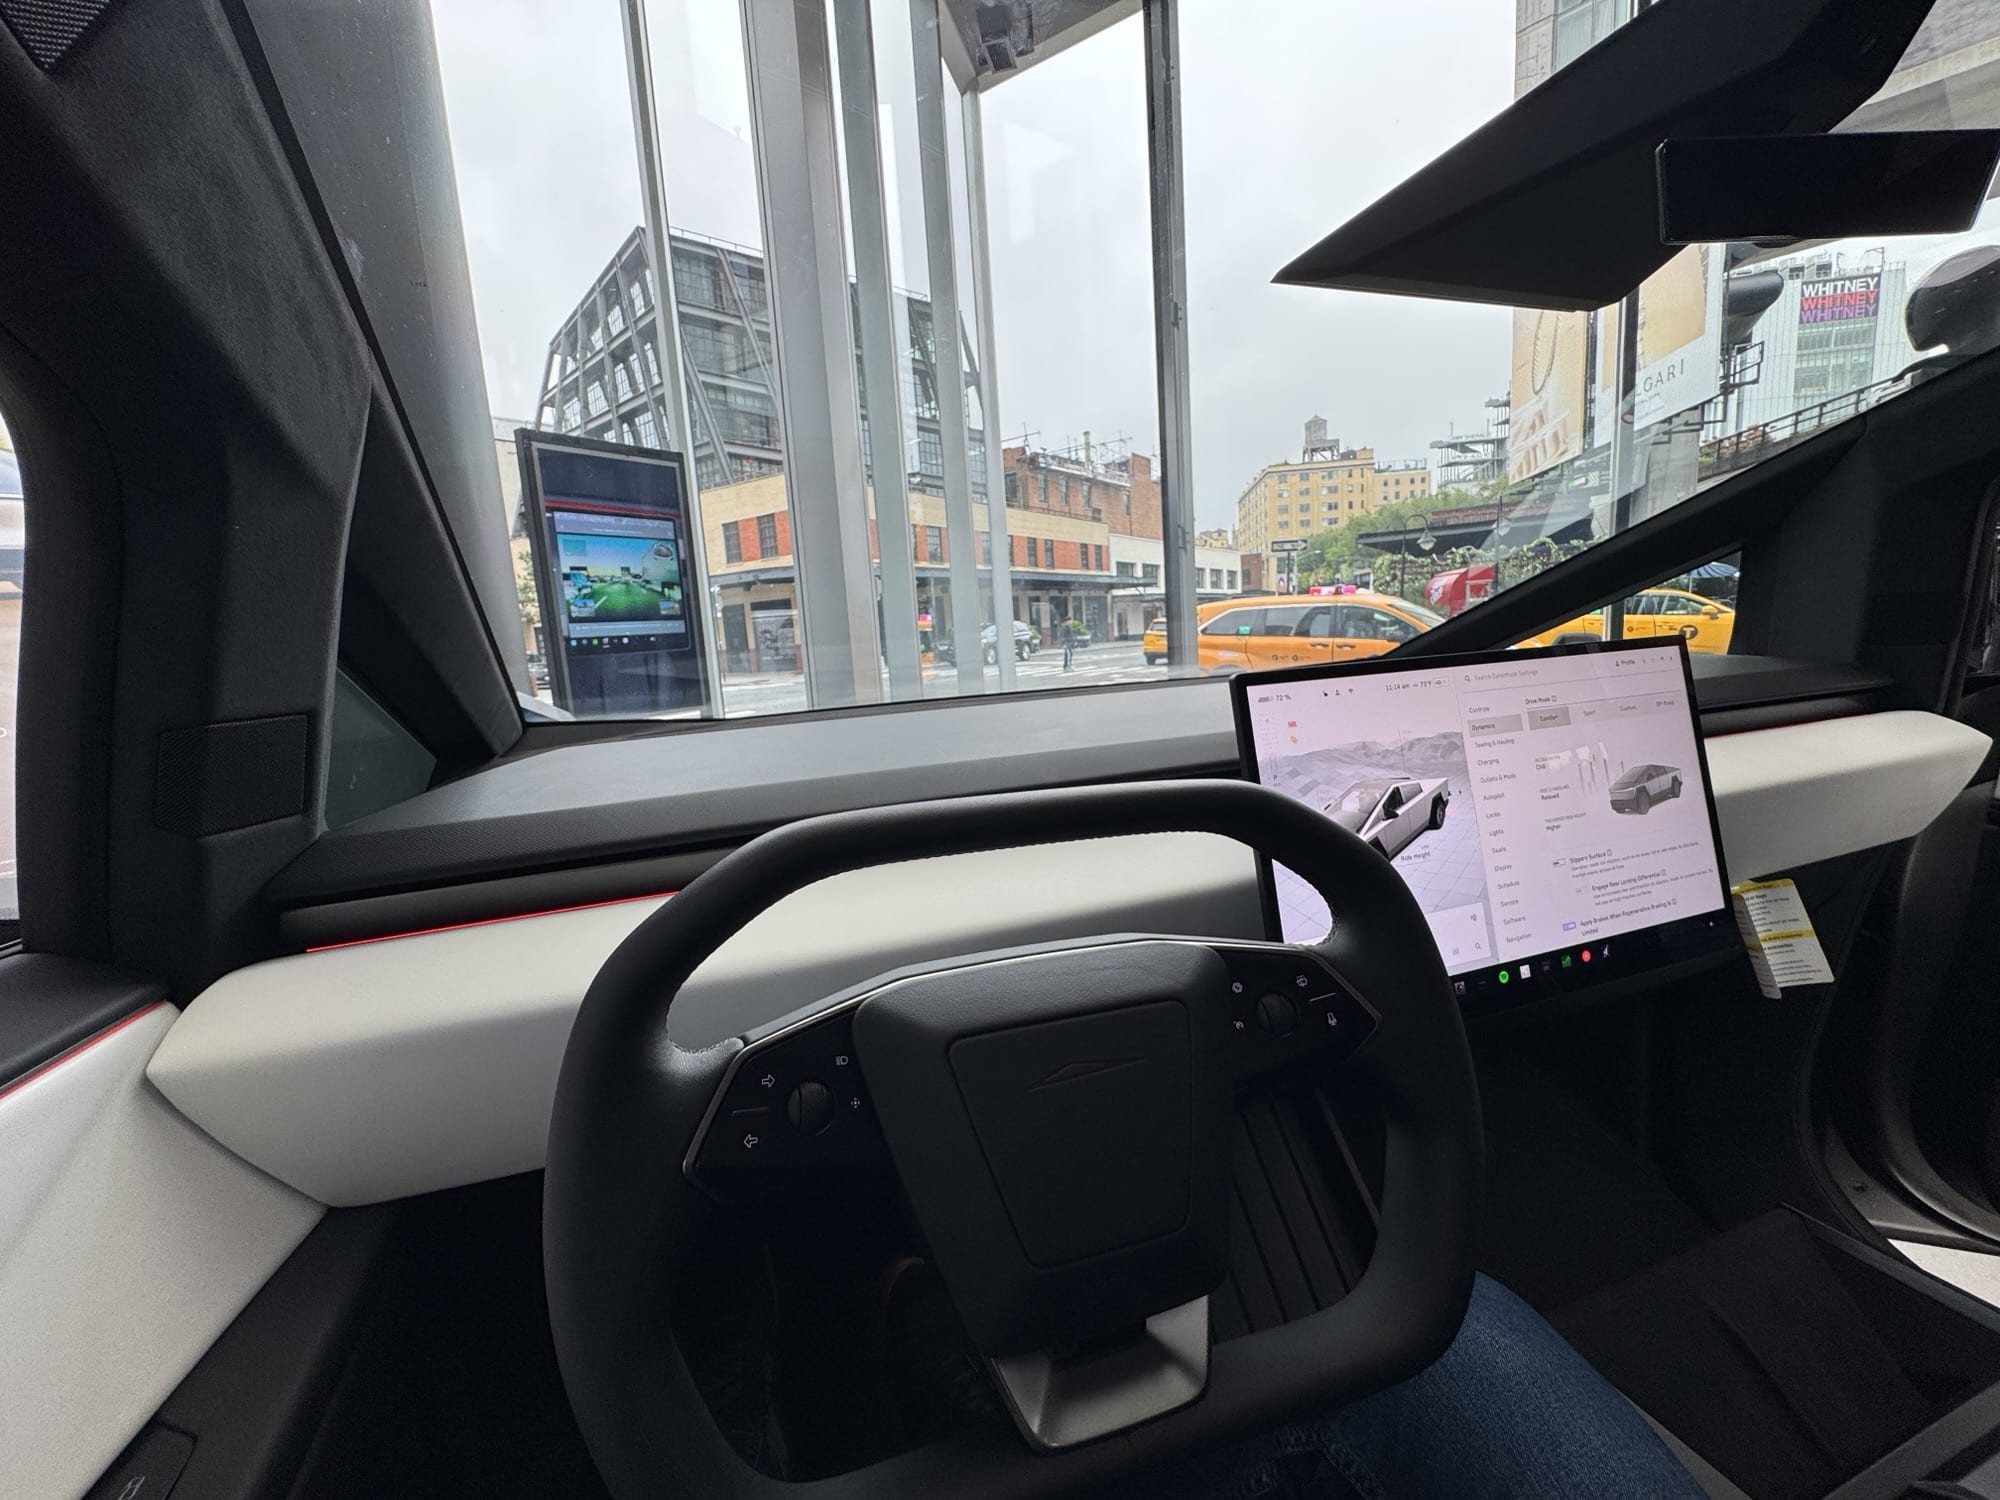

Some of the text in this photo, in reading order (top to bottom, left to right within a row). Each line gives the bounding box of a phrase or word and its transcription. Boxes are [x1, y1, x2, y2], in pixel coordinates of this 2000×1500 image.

[1802, 276, 1879, 298] WHITNEY
[1802, 290, 1877, 311] WHITNEY
[1801, 303, 1877, 323] WHITNEY
[1540, 714, 1558, 722] Comfort
[1471, 723, 1496, 732] Dynamics
[1496, 738, 1515, 746] Hauling
[1477, 758, 1499, 767] Charging
[1480, 776, 1498, 784] Outlets
[1483, 791, 1505, 800] Autopilot
[1485, 811, 1500, 819] Locks
[1488, 828, 1504, 837] Lights
[1491, 846, 1507, 854] Seats
[1401, 850, 1431, 861] Ride Height
[1569, 851, 1606, 864] Slippery Surface
[1494, 863, 1513, 872] Display
[1497, 879, 1520, 890] Schedule
[1592, 883, 1609, 892] Engage
[1500, 898, 1519, 908] Service
[1503, 914, 1526, 925] Software
[1580, 919, 1593, 928] Apply
[1609, 911, 1622, 919] When
[1581, 926, 1599, 937] Limited
[1506, 931, 1532, 943] Navigation
